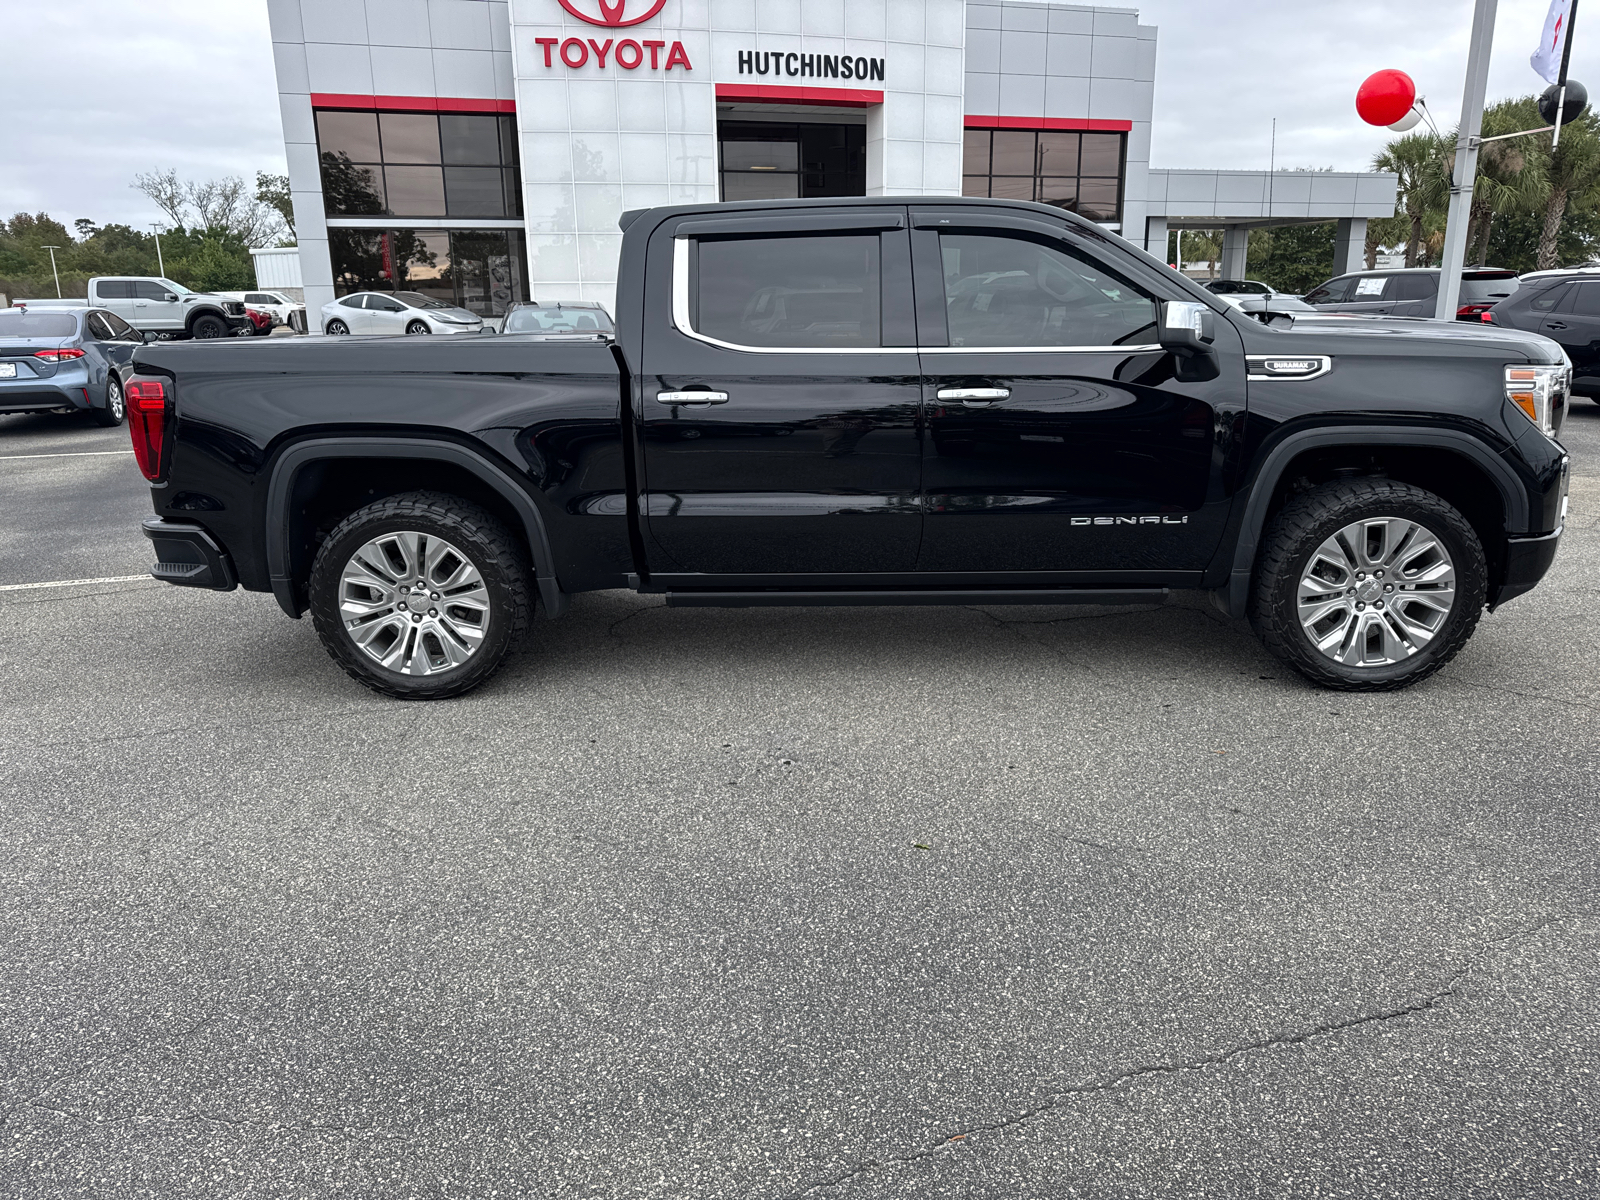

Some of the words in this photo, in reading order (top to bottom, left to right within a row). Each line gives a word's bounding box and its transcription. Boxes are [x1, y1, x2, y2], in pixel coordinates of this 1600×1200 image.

[535, 37, 692, 70] TOYOTA
[738, 50, 885, 81] HUTCHINSON
[1070, 515, 1188, 525] DENALI
